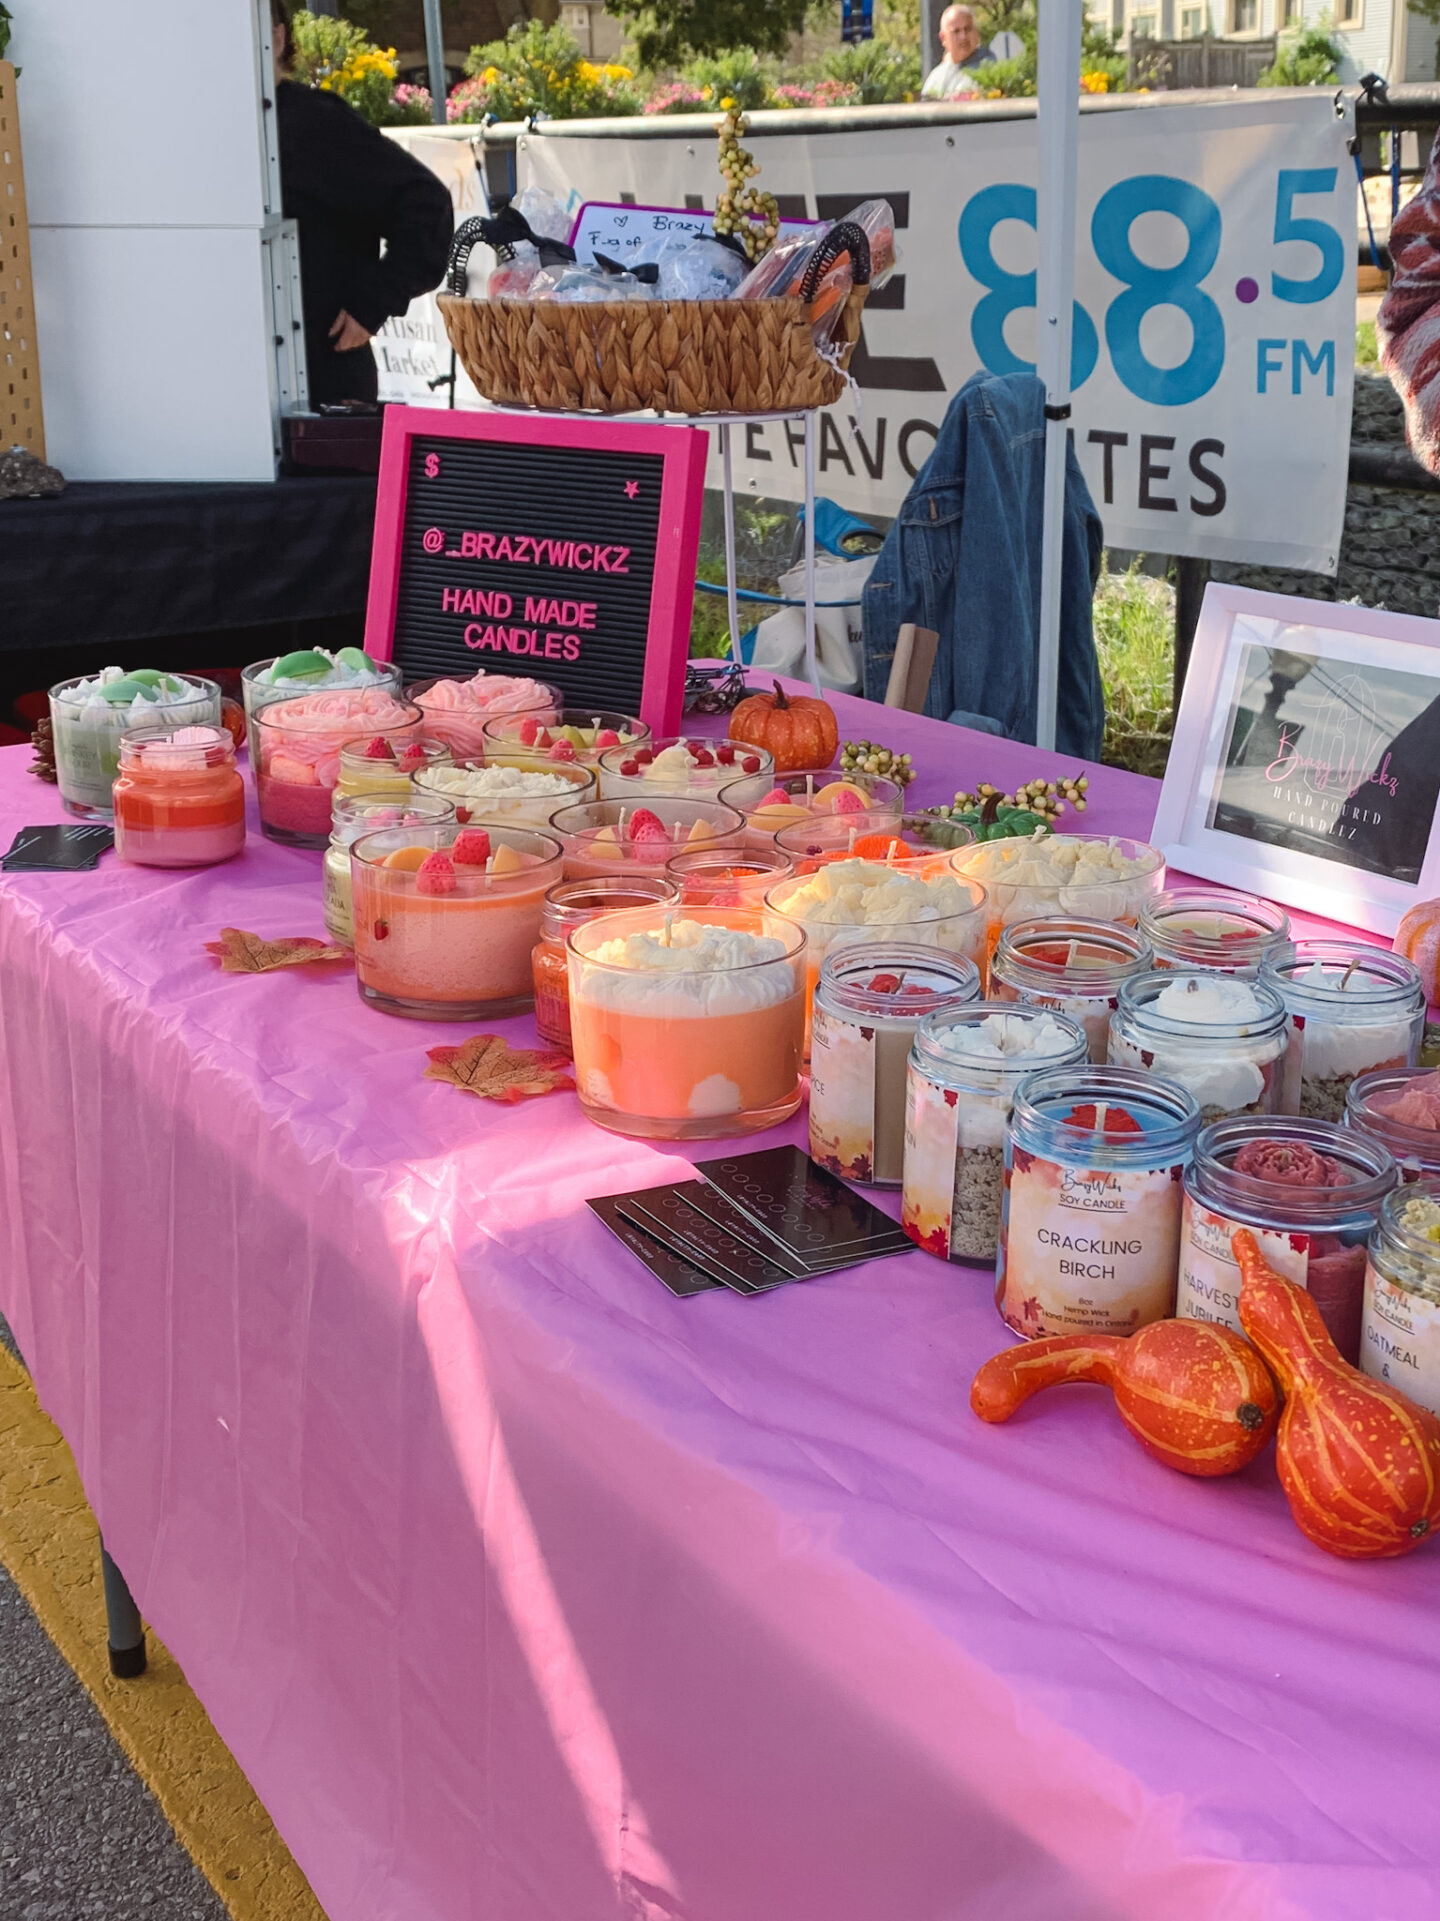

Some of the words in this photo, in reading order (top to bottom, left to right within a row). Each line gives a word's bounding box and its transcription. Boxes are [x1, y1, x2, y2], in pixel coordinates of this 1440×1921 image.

[652, 215, 705, 234] Brazy
[626, 236, 642, 248] of
[957, 167, 1346, 407] 88.5
[382, 316, 438, 344] rtisan
[1256, 338, 1336, 397] FM
[423, 452, 442, 479] $
[422, 526, 631, 574] @_BRAZYWICKZ
[441, 587, 513, 619] HAND
[523, 596, 599, 630] MADE
[463, 623, 582, 662] CANDLES
[1273, 786, 1313, 807] HAND
[1321, 798, 1382, 826] POURED
[1288, 810, 1358, 841] CANDLEZ
[1060, 1193, 1080, 1205] SOY
[1083, 1198, 1126, 1209] CANDLE
[1037, 1228, 1143, 1255] CRACKLING
[1059, 1259, 1115, 1280] BIRCH
[1184, 1268, 1239, 1312] HARVEST
[1064, 1305, 1089, 1316] Hemp
[1367, 1325, 1421, 1370] OATMEAL
[1382, 1363, 1391, 1380] &
